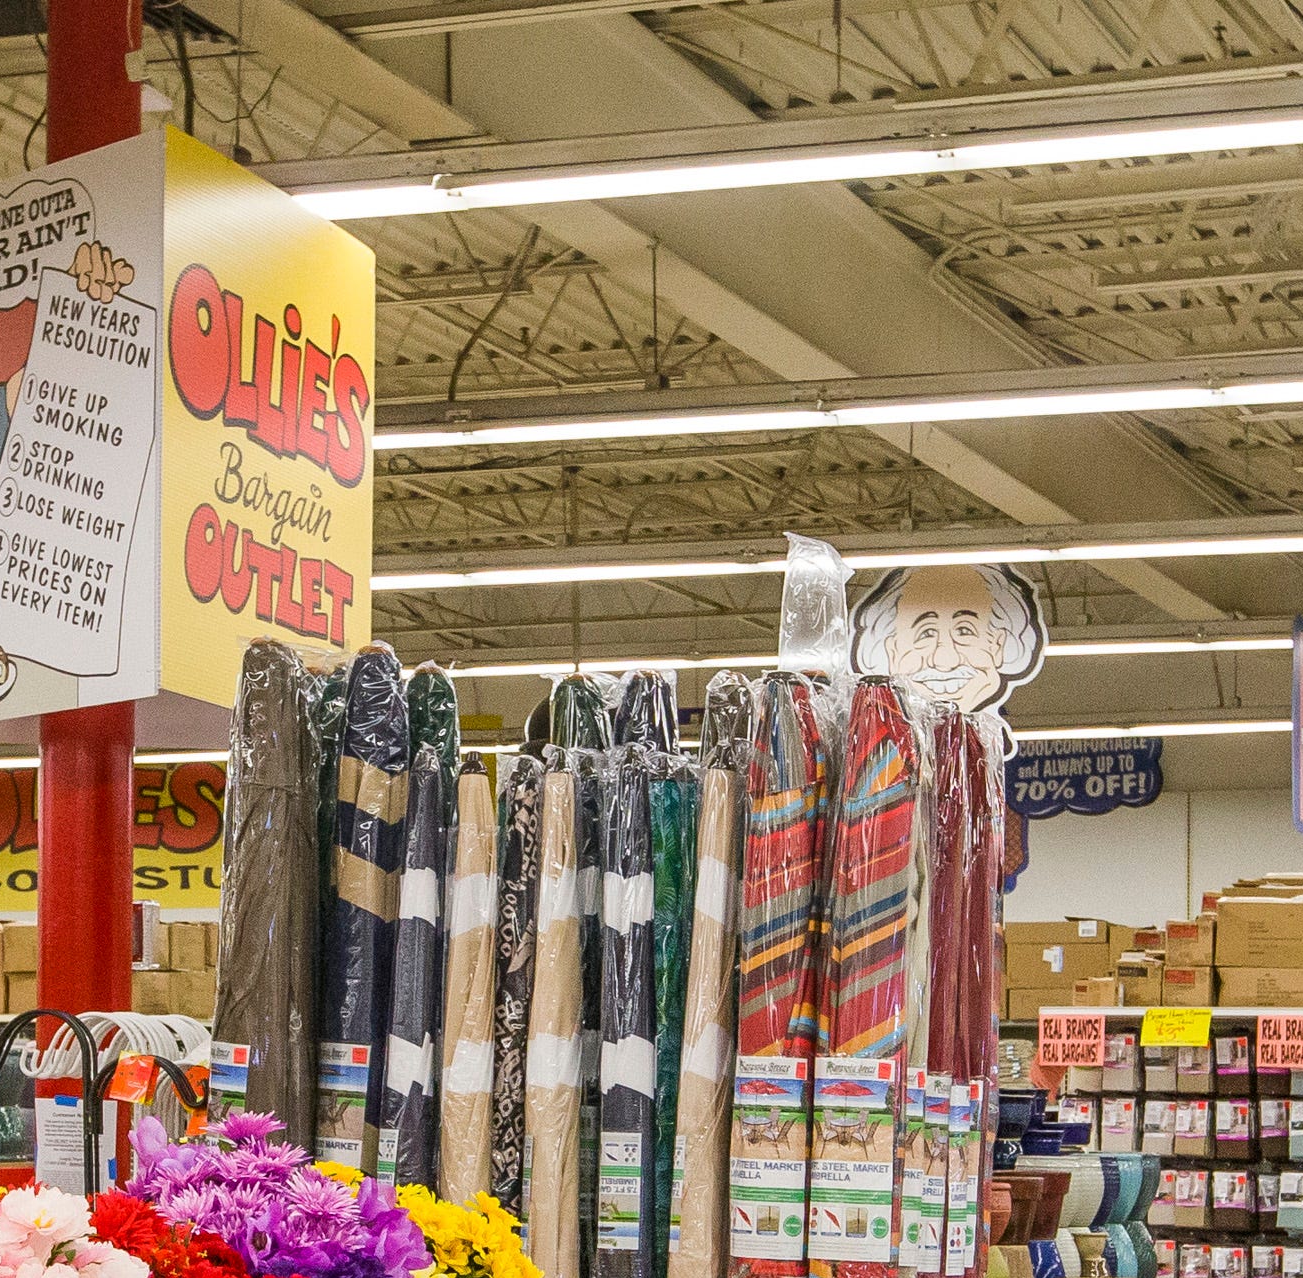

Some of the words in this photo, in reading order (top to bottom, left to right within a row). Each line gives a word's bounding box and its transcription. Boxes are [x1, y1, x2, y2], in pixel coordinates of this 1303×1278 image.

[28, 187, 77, 222] OUTA
[16, 211, 91, 256] AIN'T
[49, 295, 86, 322] NEW
[90, 304, 141, 337] YEARS
[42, 321, 151, 369] RESOLUTION
[39, 380, 78, 408] GIVE
[85, 393, 109, 416] UP
[33, 404, 123, 447] SMOKING
[29, 440, 75, 467] STOP
[22, 458, 105, 500] DRINKING
[214, 441, 333, 545] Bargain
[17, 491, 55, 520] LOSE
[61, 504, 126, 543] WEIGHT
[11, 532, 46, 561] GIVE
[52, 546, 114, 584] LOWEST
[184, 502, 354, 650] OUTLET
[7, 555, 73, 595] PRICES
[80, 581, 107, 607] ON
[0, 581, 52, 614] EVERY
[56, 599, 103, 633] ITEM!
[1018, 759, 1039, 780] and
[1043, 757, 1092, 777] ALWAYS
[1097, 755, 1114, 773] UP
[1119, 754, 1135, 772] TO
[1014, 778, 1076, 802] 70%
[1085, 772, 1147, 798] OFF!
[1042, 1018, 1063, 1040] REAL
[1065, 1017, 1102, 1040] BRANDS!
[1261, 1019, 1283, 1041] REAL
[1042, 1042, 1060, 1063] REAL
[1061, 1042, 1098, 1063] BARGAINS!
[1260, 1043, 1278, 1064] REAL
[325, 1139, 360, 1151] MARKET
[763, 1161, 803, 1171] MARKET
[822, 1162, 851, 1172] STEEL
[853, 1163, 890, 1173] MARKET
